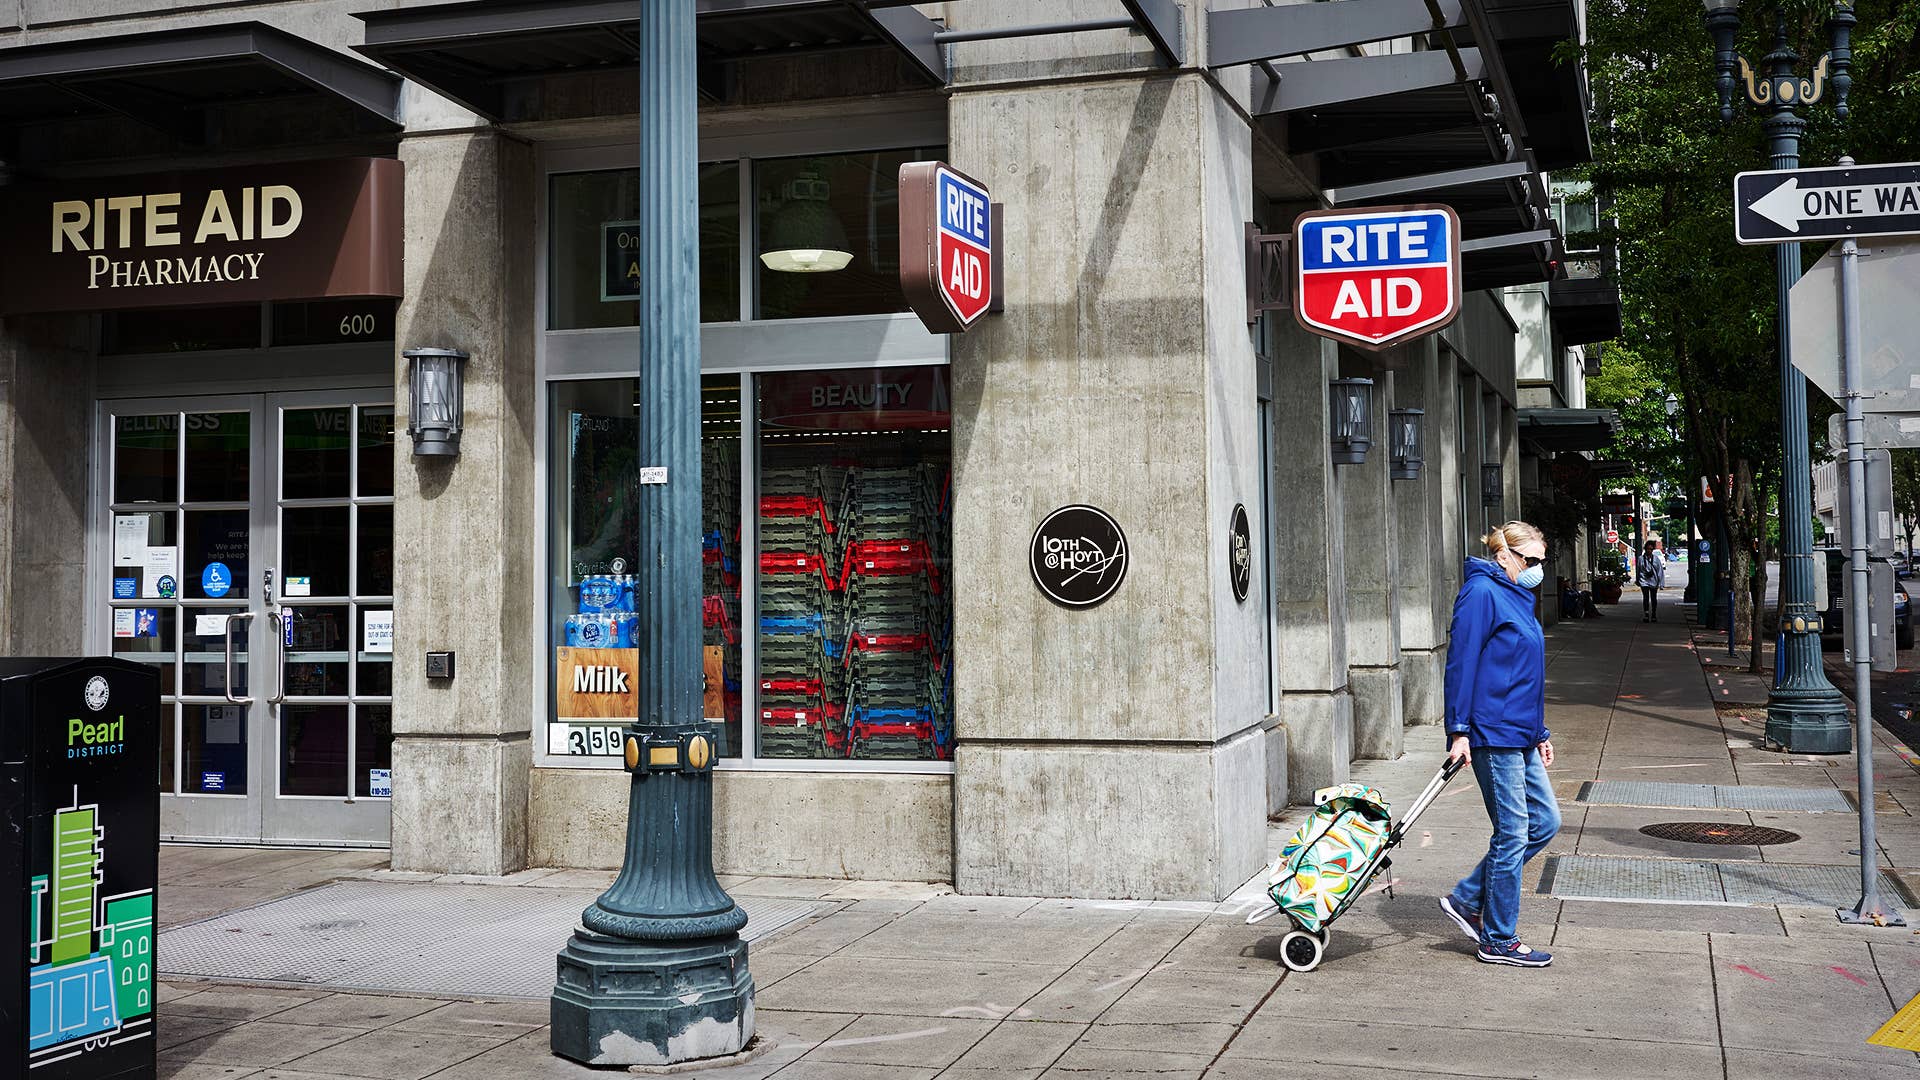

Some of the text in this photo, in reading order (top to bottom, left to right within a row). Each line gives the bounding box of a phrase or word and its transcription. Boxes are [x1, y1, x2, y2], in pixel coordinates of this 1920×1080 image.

[946, 182, 985, 240] RITE
[1803, 186, 1920, 217] ONE WA
[52, 184, 303, 253] RITE AID
[617, 232, 640, 249] On
[1321, 221, 1429, 264] RITE
[950, 247, 982, 300] AID
[1330, 276, 1423, 320] AID
[339, 314, 375, 336] 600
[811, 383, 913, 408] BEAUTY
[215, 543, 228, 551] We
[226, 552, 245, 560] keep
[573, 665, 628, 693] Milk
[68, 715, 124, 746] Pearl
[67, 743, 124, 759] DISTRICT
